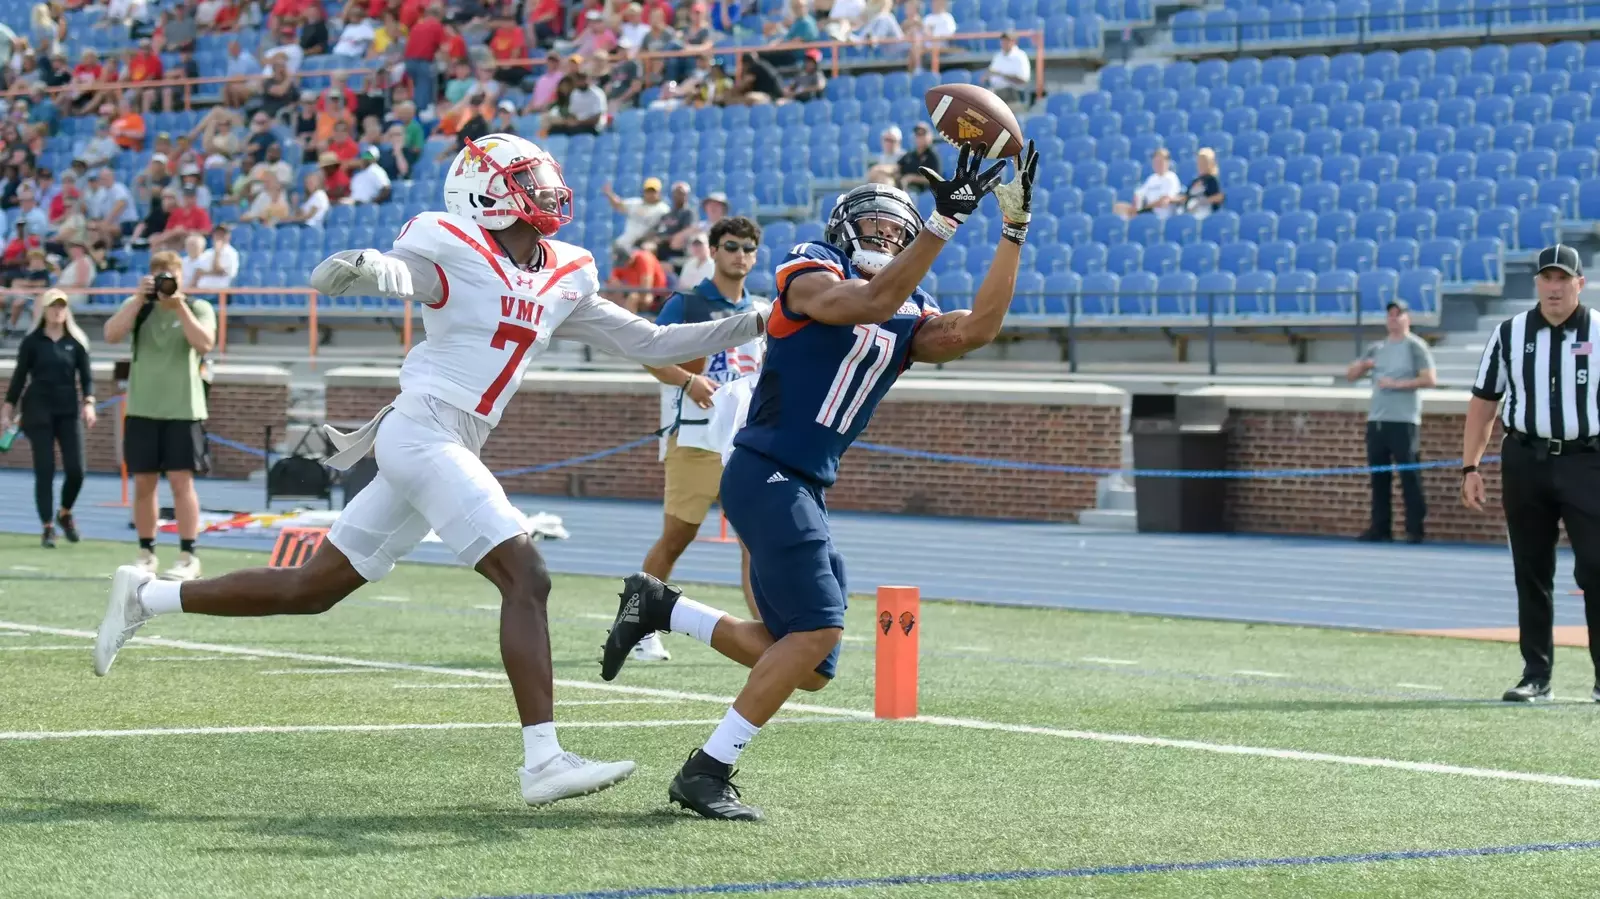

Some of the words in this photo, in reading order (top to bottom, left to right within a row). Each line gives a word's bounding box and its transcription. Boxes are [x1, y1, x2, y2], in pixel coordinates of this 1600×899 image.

[950, 193, 976, 201] adidas
[500, 295, 544, 325] VMI
[1525, 342, 1534, 353] S
[475, 321, 538, 417] 7
[815, 323, 897, 435] 11
[1577, 369, 1587, 384] S
